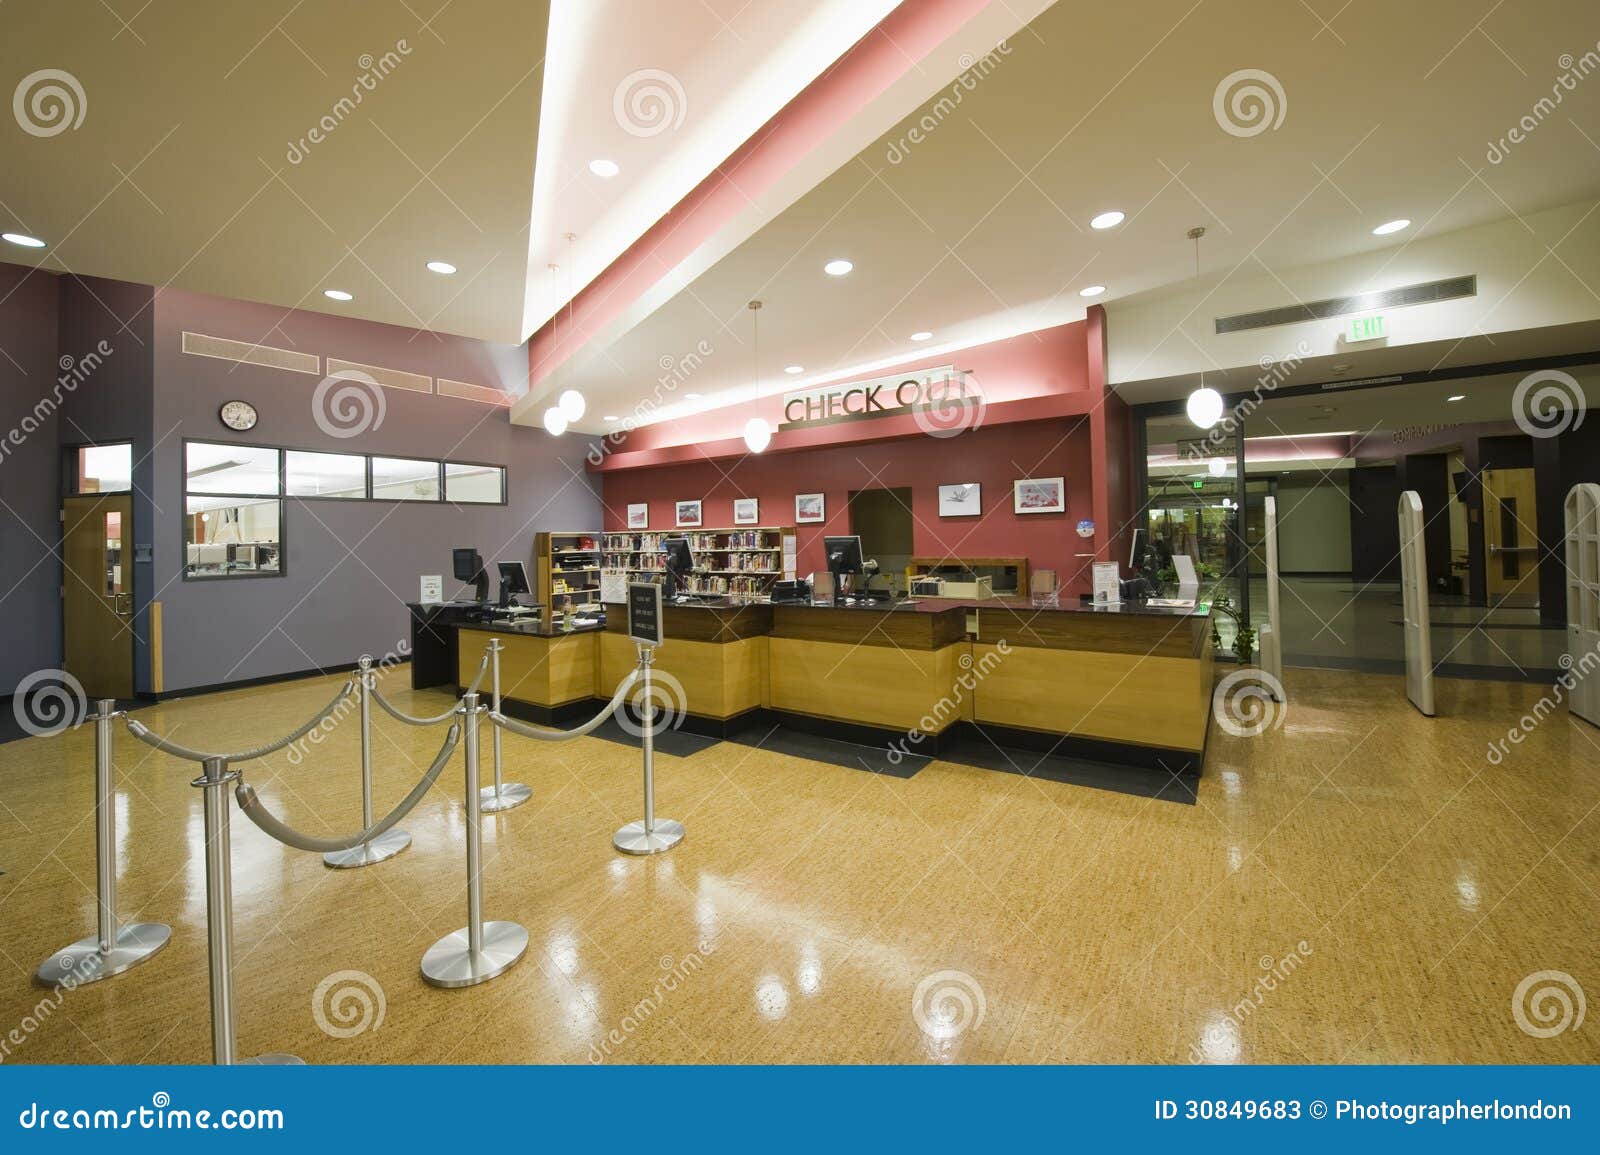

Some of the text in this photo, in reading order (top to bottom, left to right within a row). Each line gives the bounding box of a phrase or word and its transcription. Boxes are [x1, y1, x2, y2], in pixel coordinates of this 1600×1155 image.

[1351, 316, 1385, 340] EXIT
[784, 369, 975, 424] CHECK OUT
